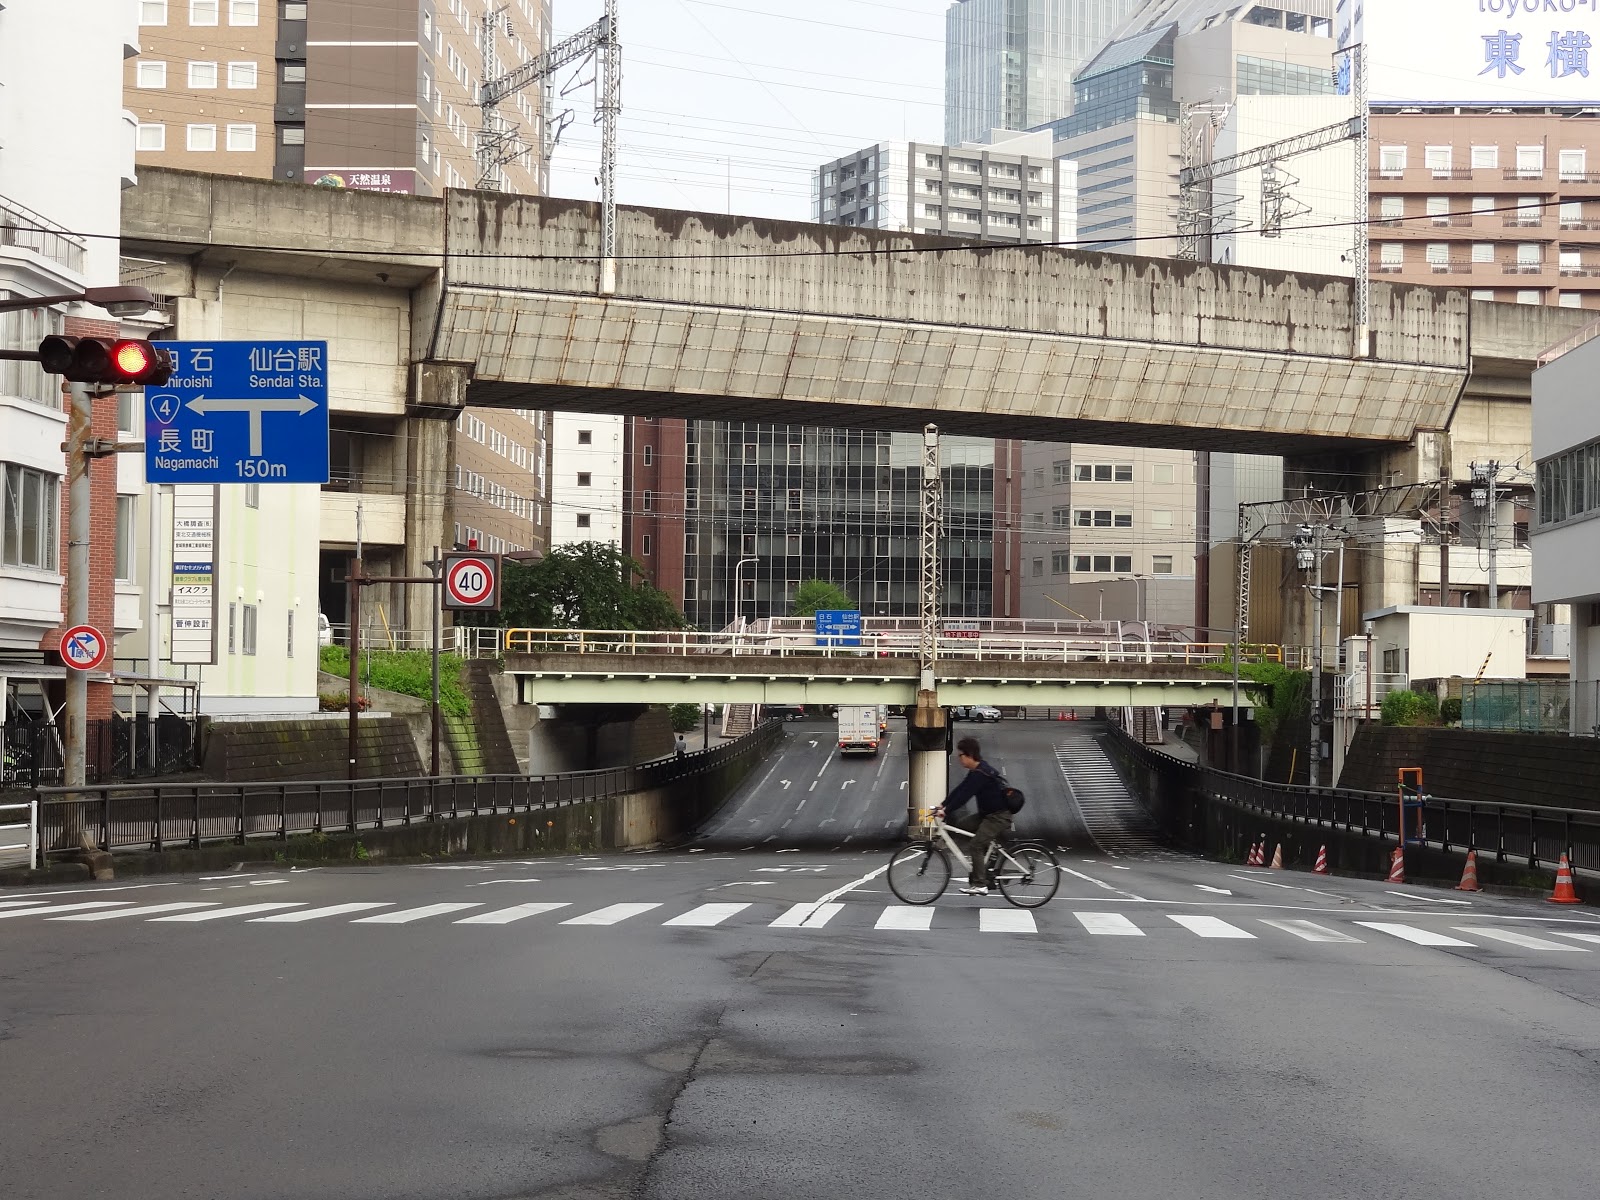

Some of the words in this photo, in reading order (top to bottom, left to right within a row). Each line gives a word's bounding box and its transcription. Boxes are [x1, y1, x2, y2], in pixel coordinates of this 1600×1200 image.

[1477, 29, 1592, 78] 東横
[349, 174, 391, 185] 天然温泉
[249, 347, 322, 372] 仙台駅
[160, 375, 213, 388] hiroishi
[250, 375, 294, 388] Sendai
[298, 376, 323, 388] Sta.
[159, 400, 171, 416] 4
[158, 428, 214, 453] 長町
[155, 456, 219, 471] Nagamachi
[235, 459, 287, 478] 150m
[459, 572, 483, 591] 40
[178, 586, 209, 594] イスクラ
